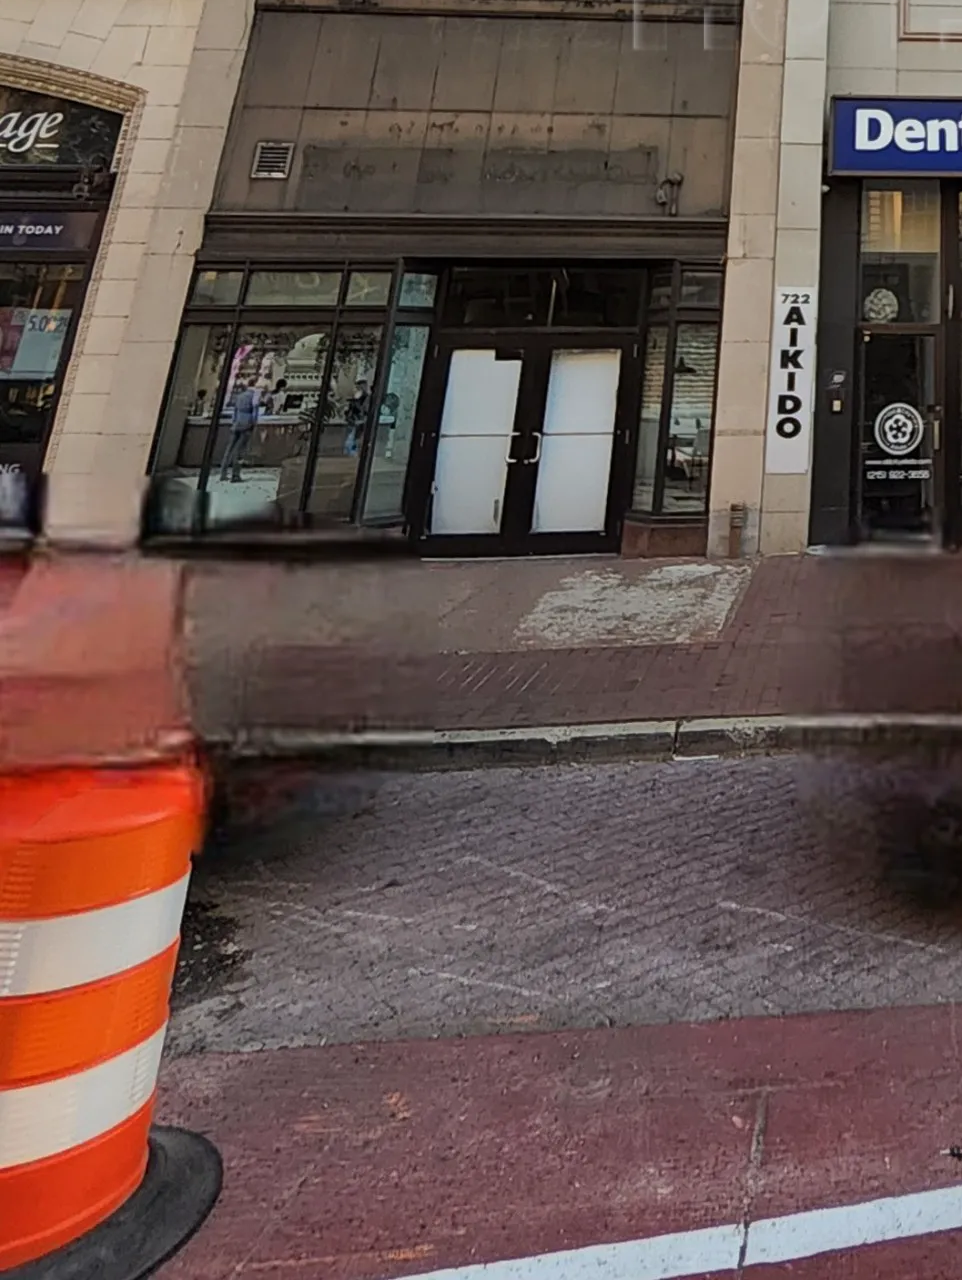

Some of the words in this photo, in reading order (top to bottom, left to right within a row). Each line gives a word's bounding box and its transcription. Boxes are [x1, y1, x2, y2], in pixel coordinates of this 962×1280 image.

[18, 224, 64, 235] TODAY
[780, 293, 811, 305] 722
[775, 305, 807, 440] AIKIDO
